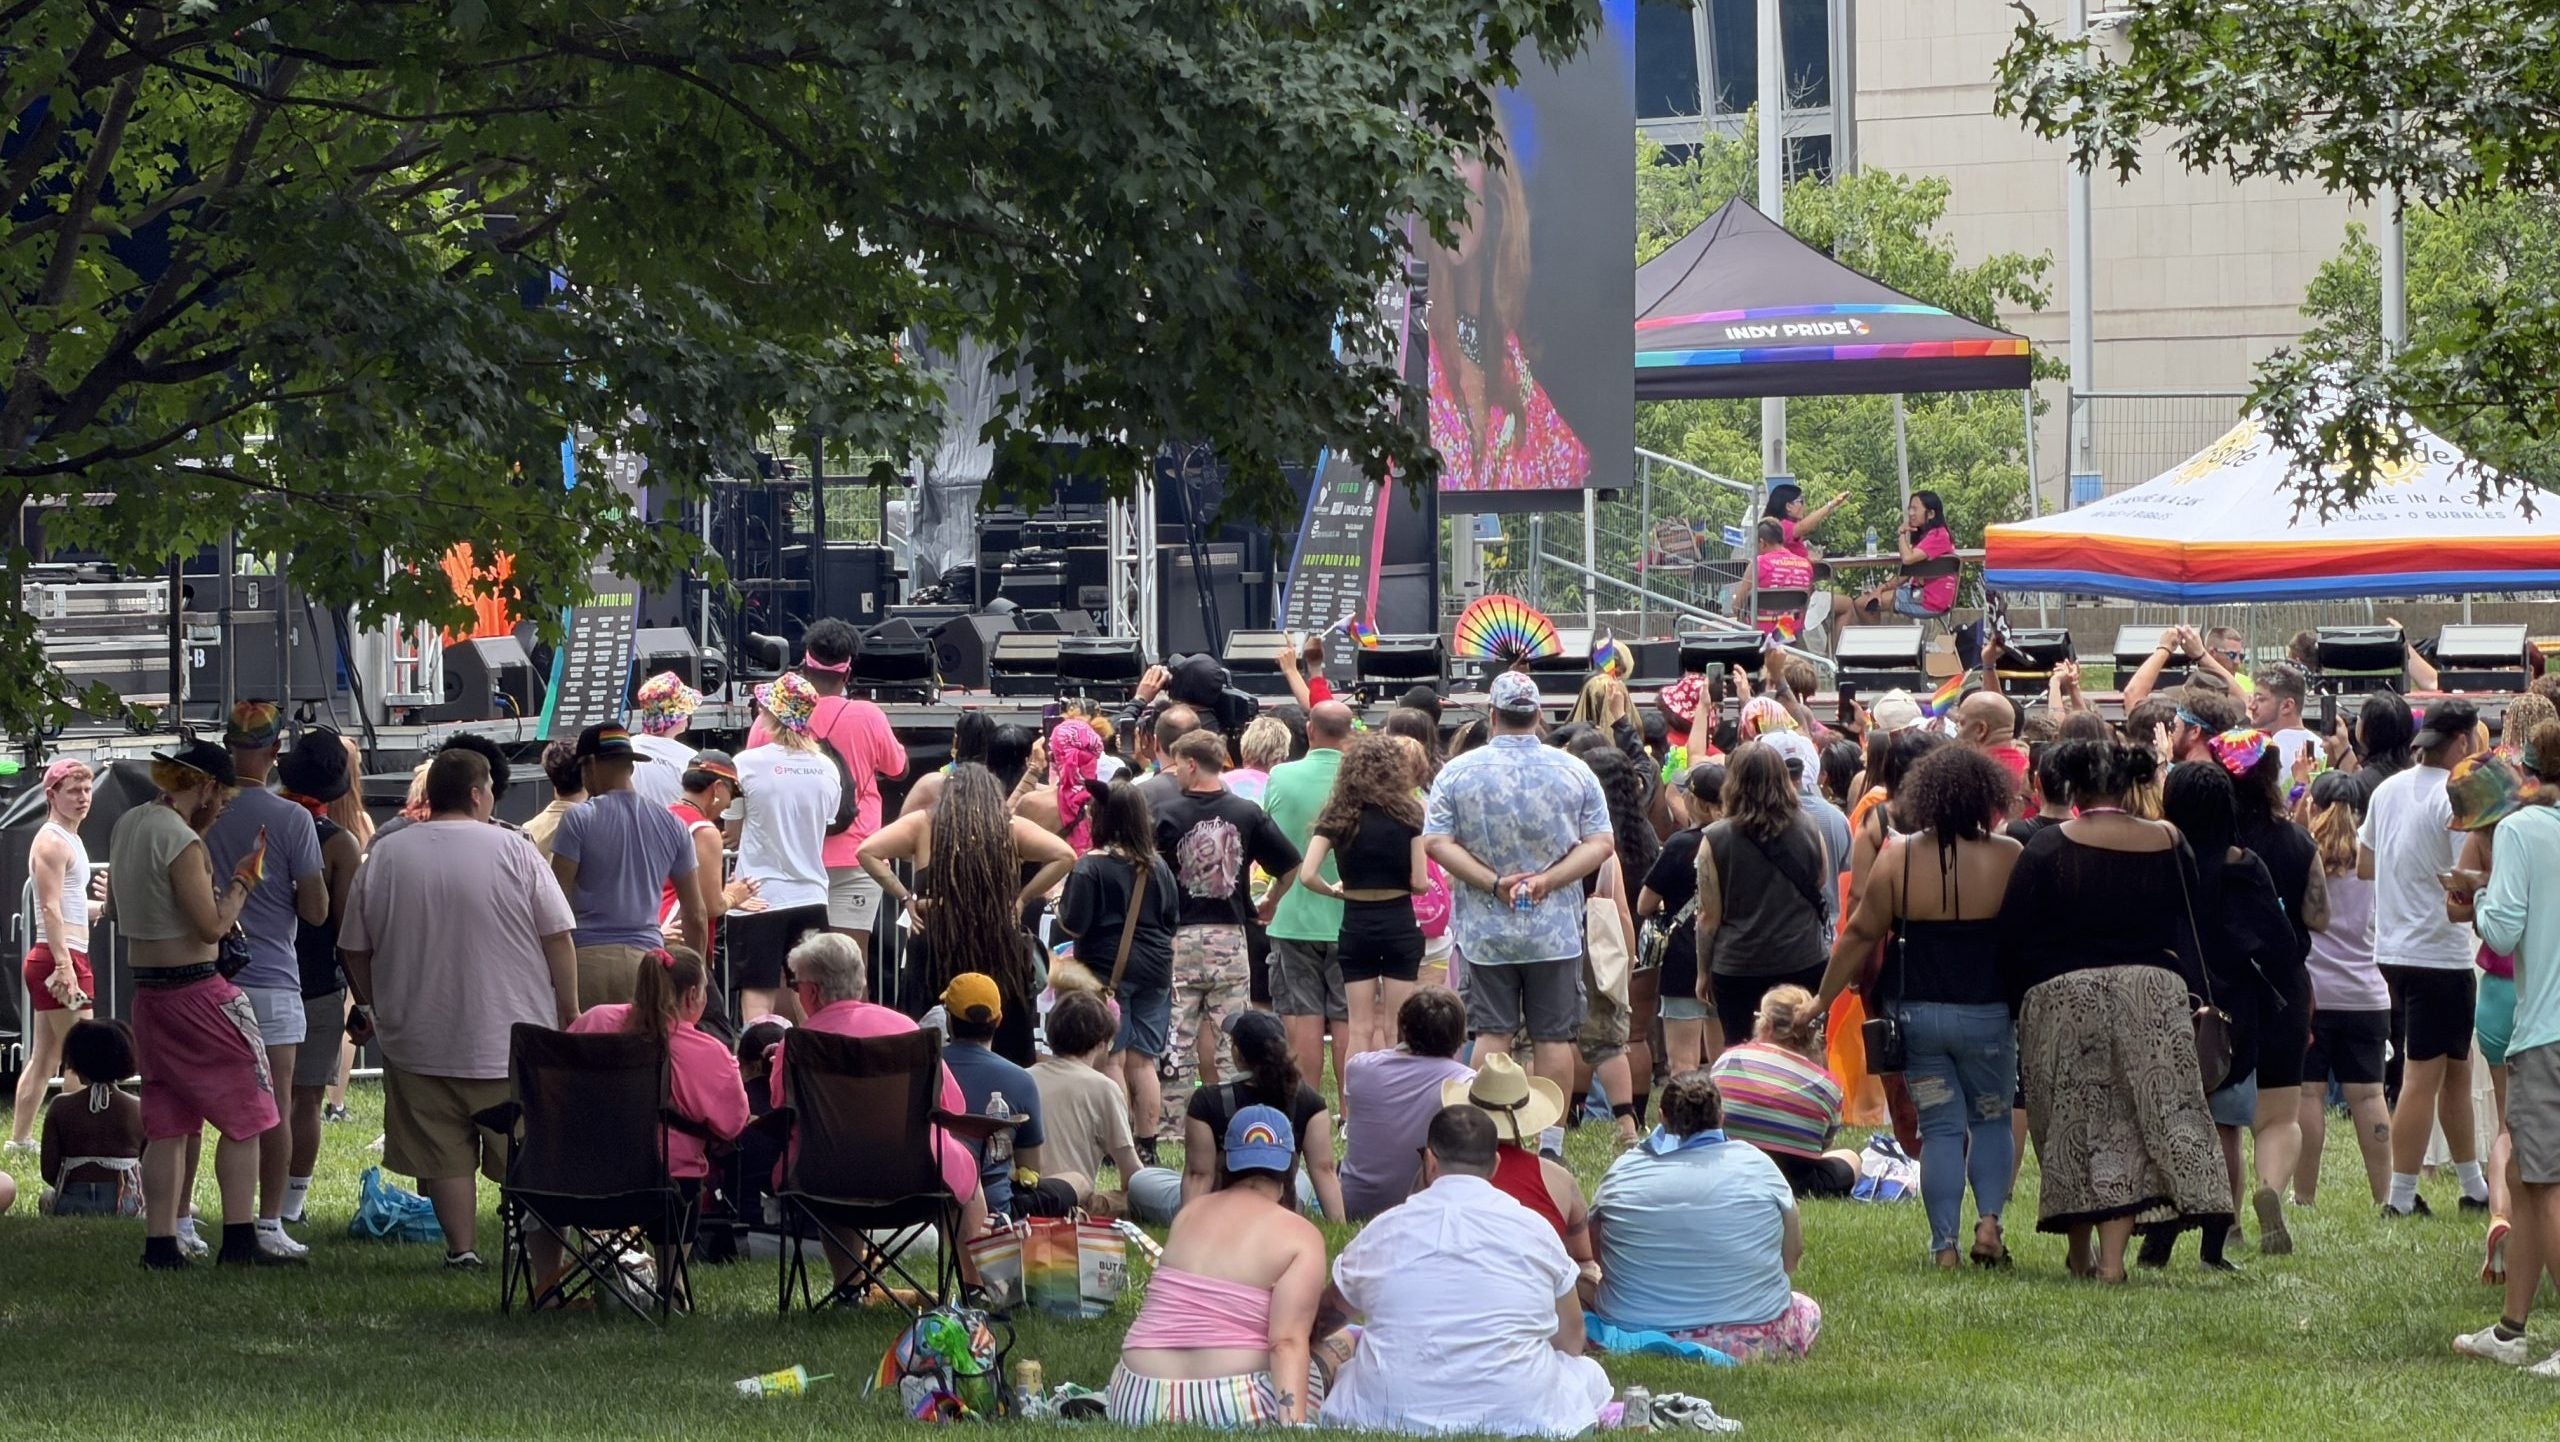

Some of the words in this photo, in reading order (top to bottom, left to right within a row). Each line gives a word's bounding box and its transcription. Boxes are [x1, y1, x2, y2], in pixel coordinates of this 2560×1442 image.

[1725, 325, 1778, 340] INDY
[1782, 321, 1850, 337] PRIDE
[2426, 511, 2507, 520] BUBBLES
[599, 593, 619, 608] PRIDE
[1099, 1260, 1118, 1273] BUT
